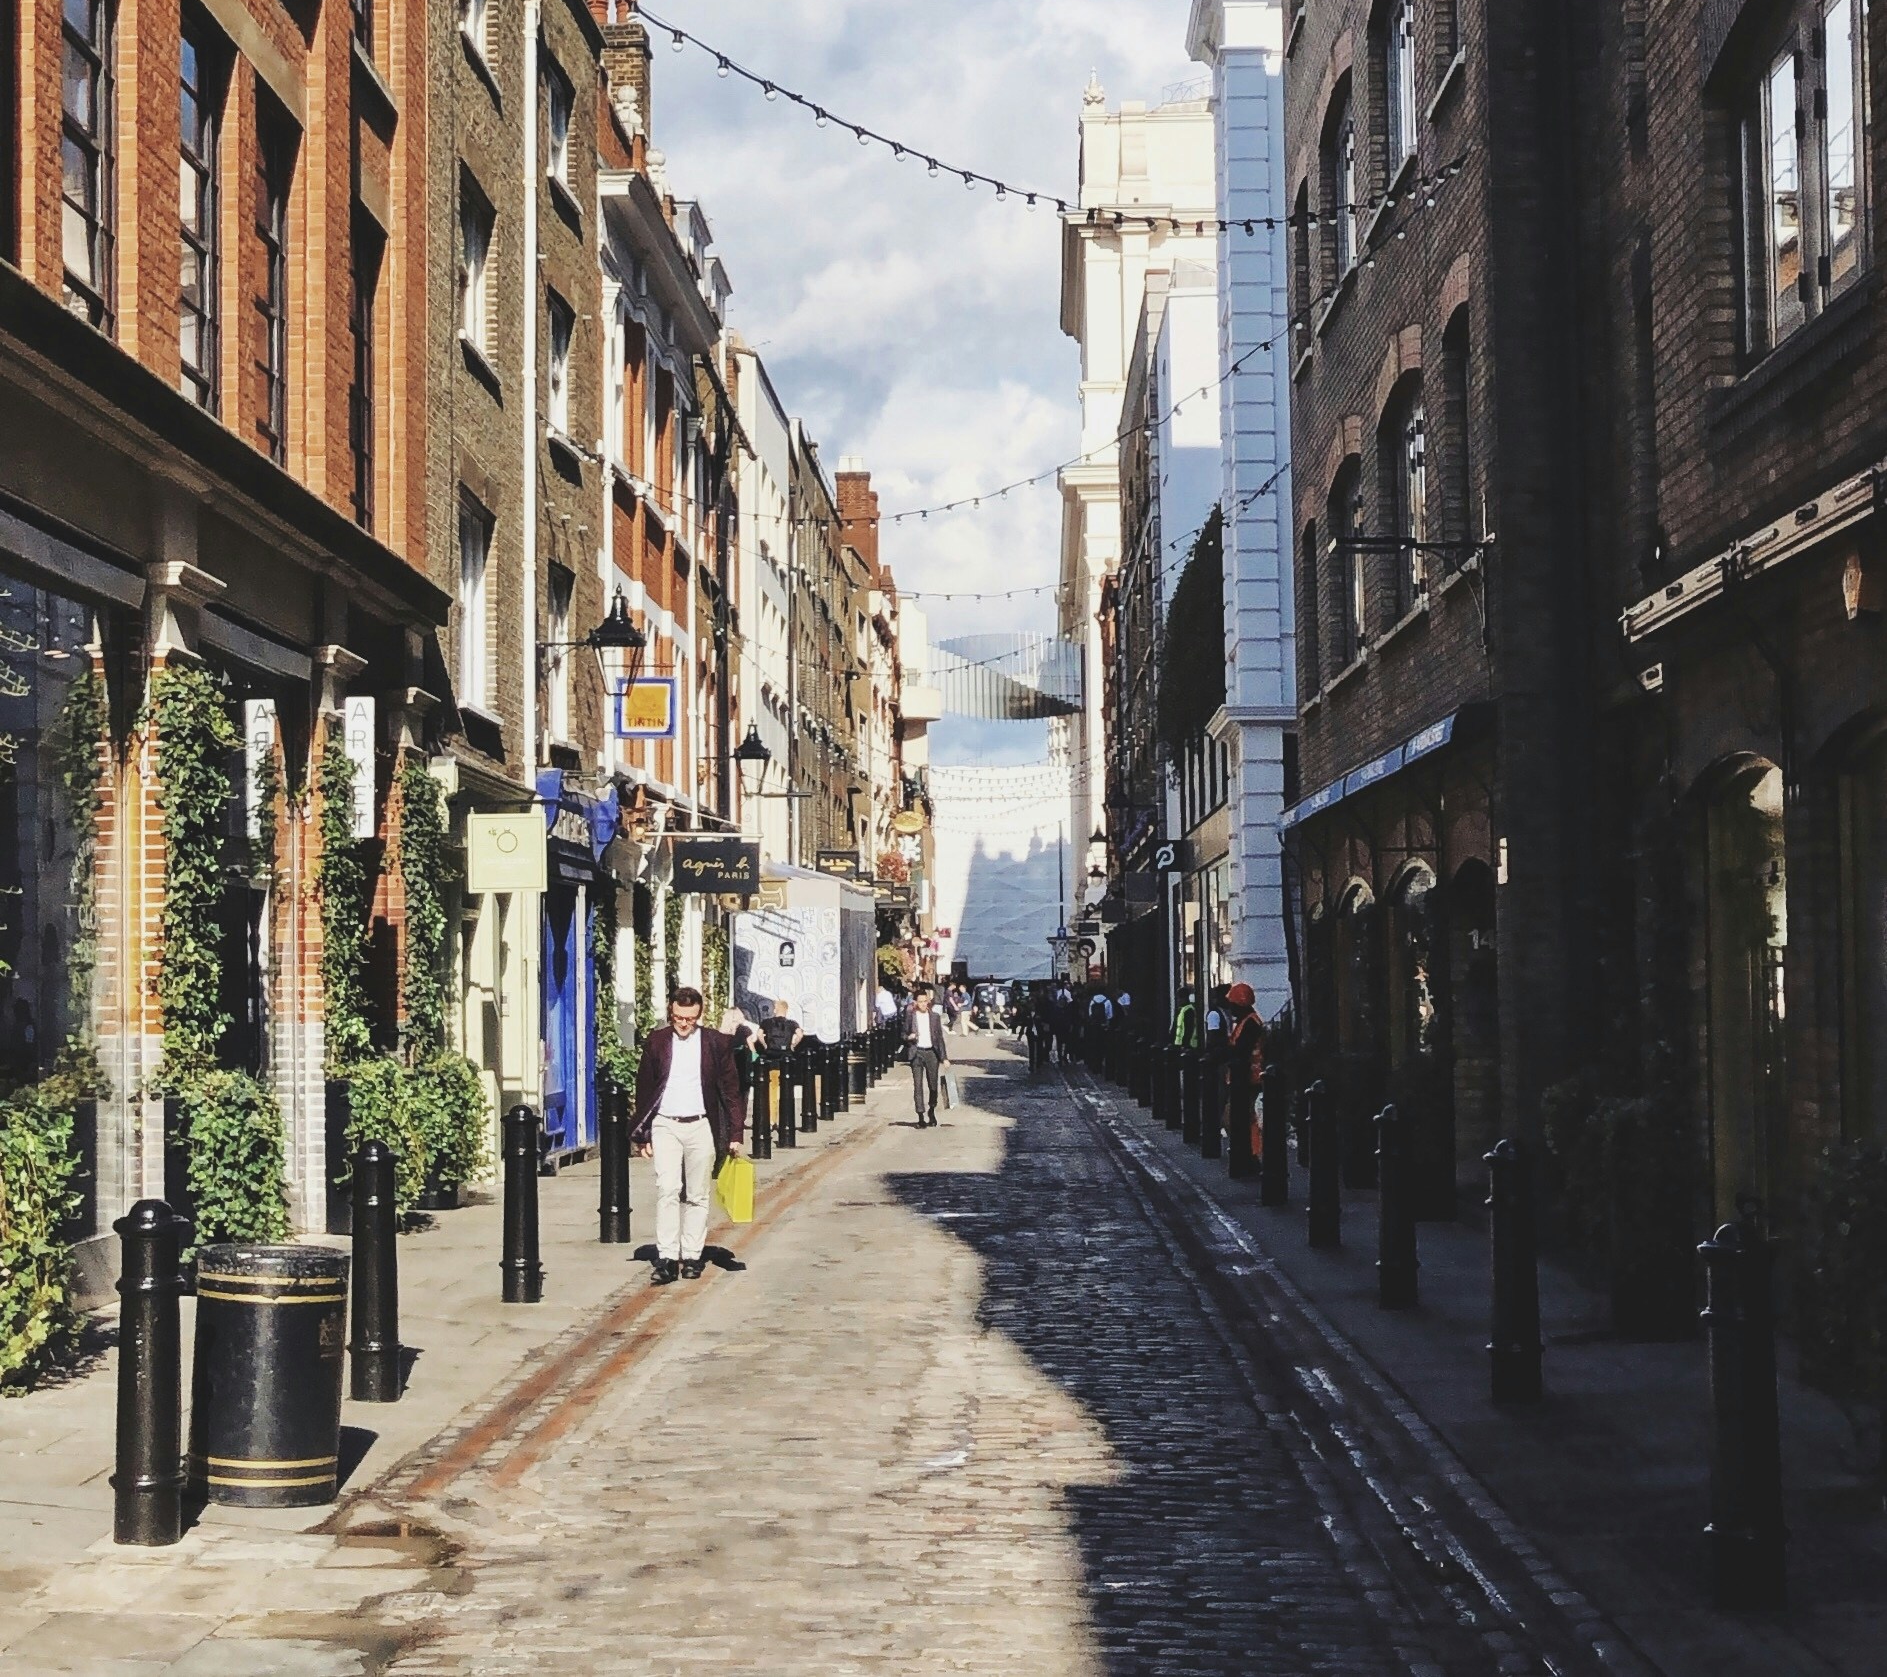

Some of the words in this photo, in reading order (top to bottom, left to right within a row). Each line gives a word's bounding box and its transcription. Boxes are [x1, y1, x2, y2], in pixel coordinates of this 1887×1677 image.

[626, 717, 665, 727] TINTIN
[351, 701, 368, 832] ARKET
[717, 871, 750, 880] PARIS
